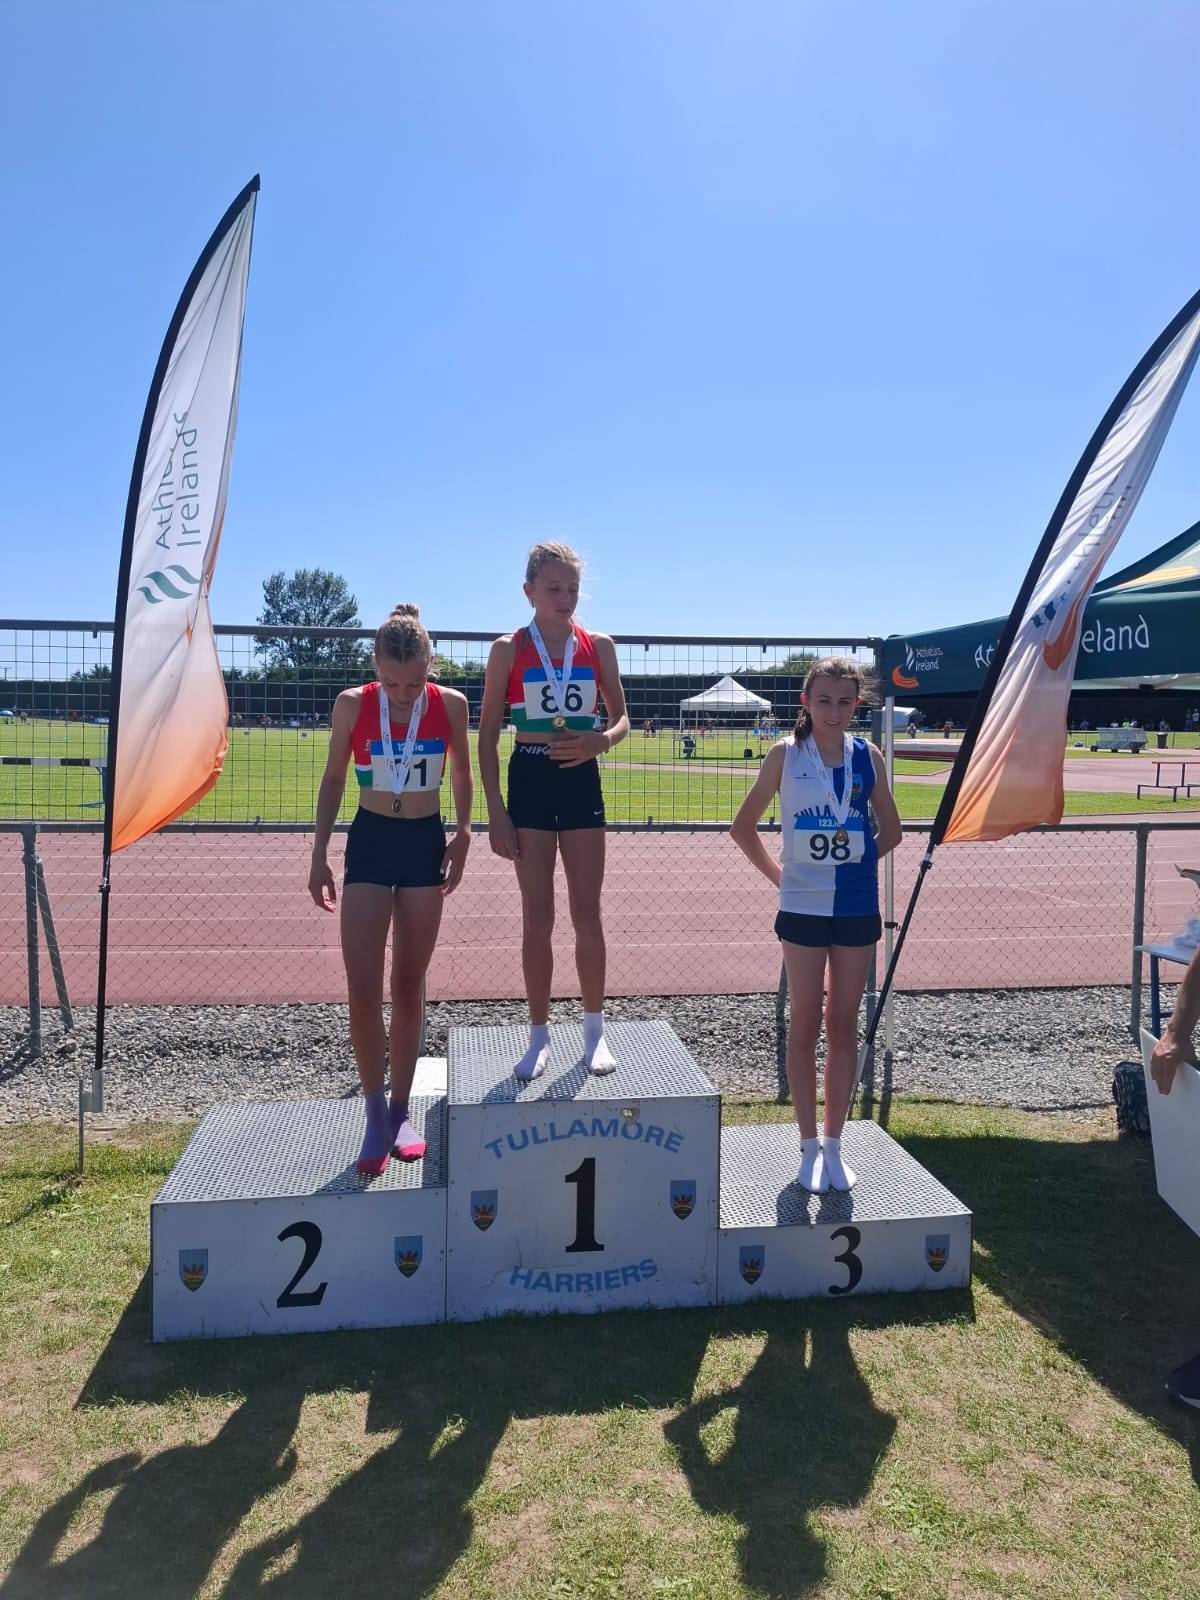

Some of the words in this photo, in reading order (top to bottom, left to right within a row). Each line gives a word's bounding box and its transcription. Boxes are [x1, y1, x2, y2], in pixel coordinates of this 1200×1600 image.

[176, 428, 202, 547] Ireland
[1080, 613, 1150, 653] eland
[915, 658, 940, 671] Ireland
[541, 683, 583, 713] 86
[519, 744, 552, 756] NIK
[809, 833, 851, 861] 98
[484, 1117, 685, 1161] TULLAMORE
[564, 1157, 605, 1253] 1
[276, 1220, 329, 1309] 2
[509, 1258, 659, 1294] HARRIERS
[828, 1225, 863, 1295] 3
